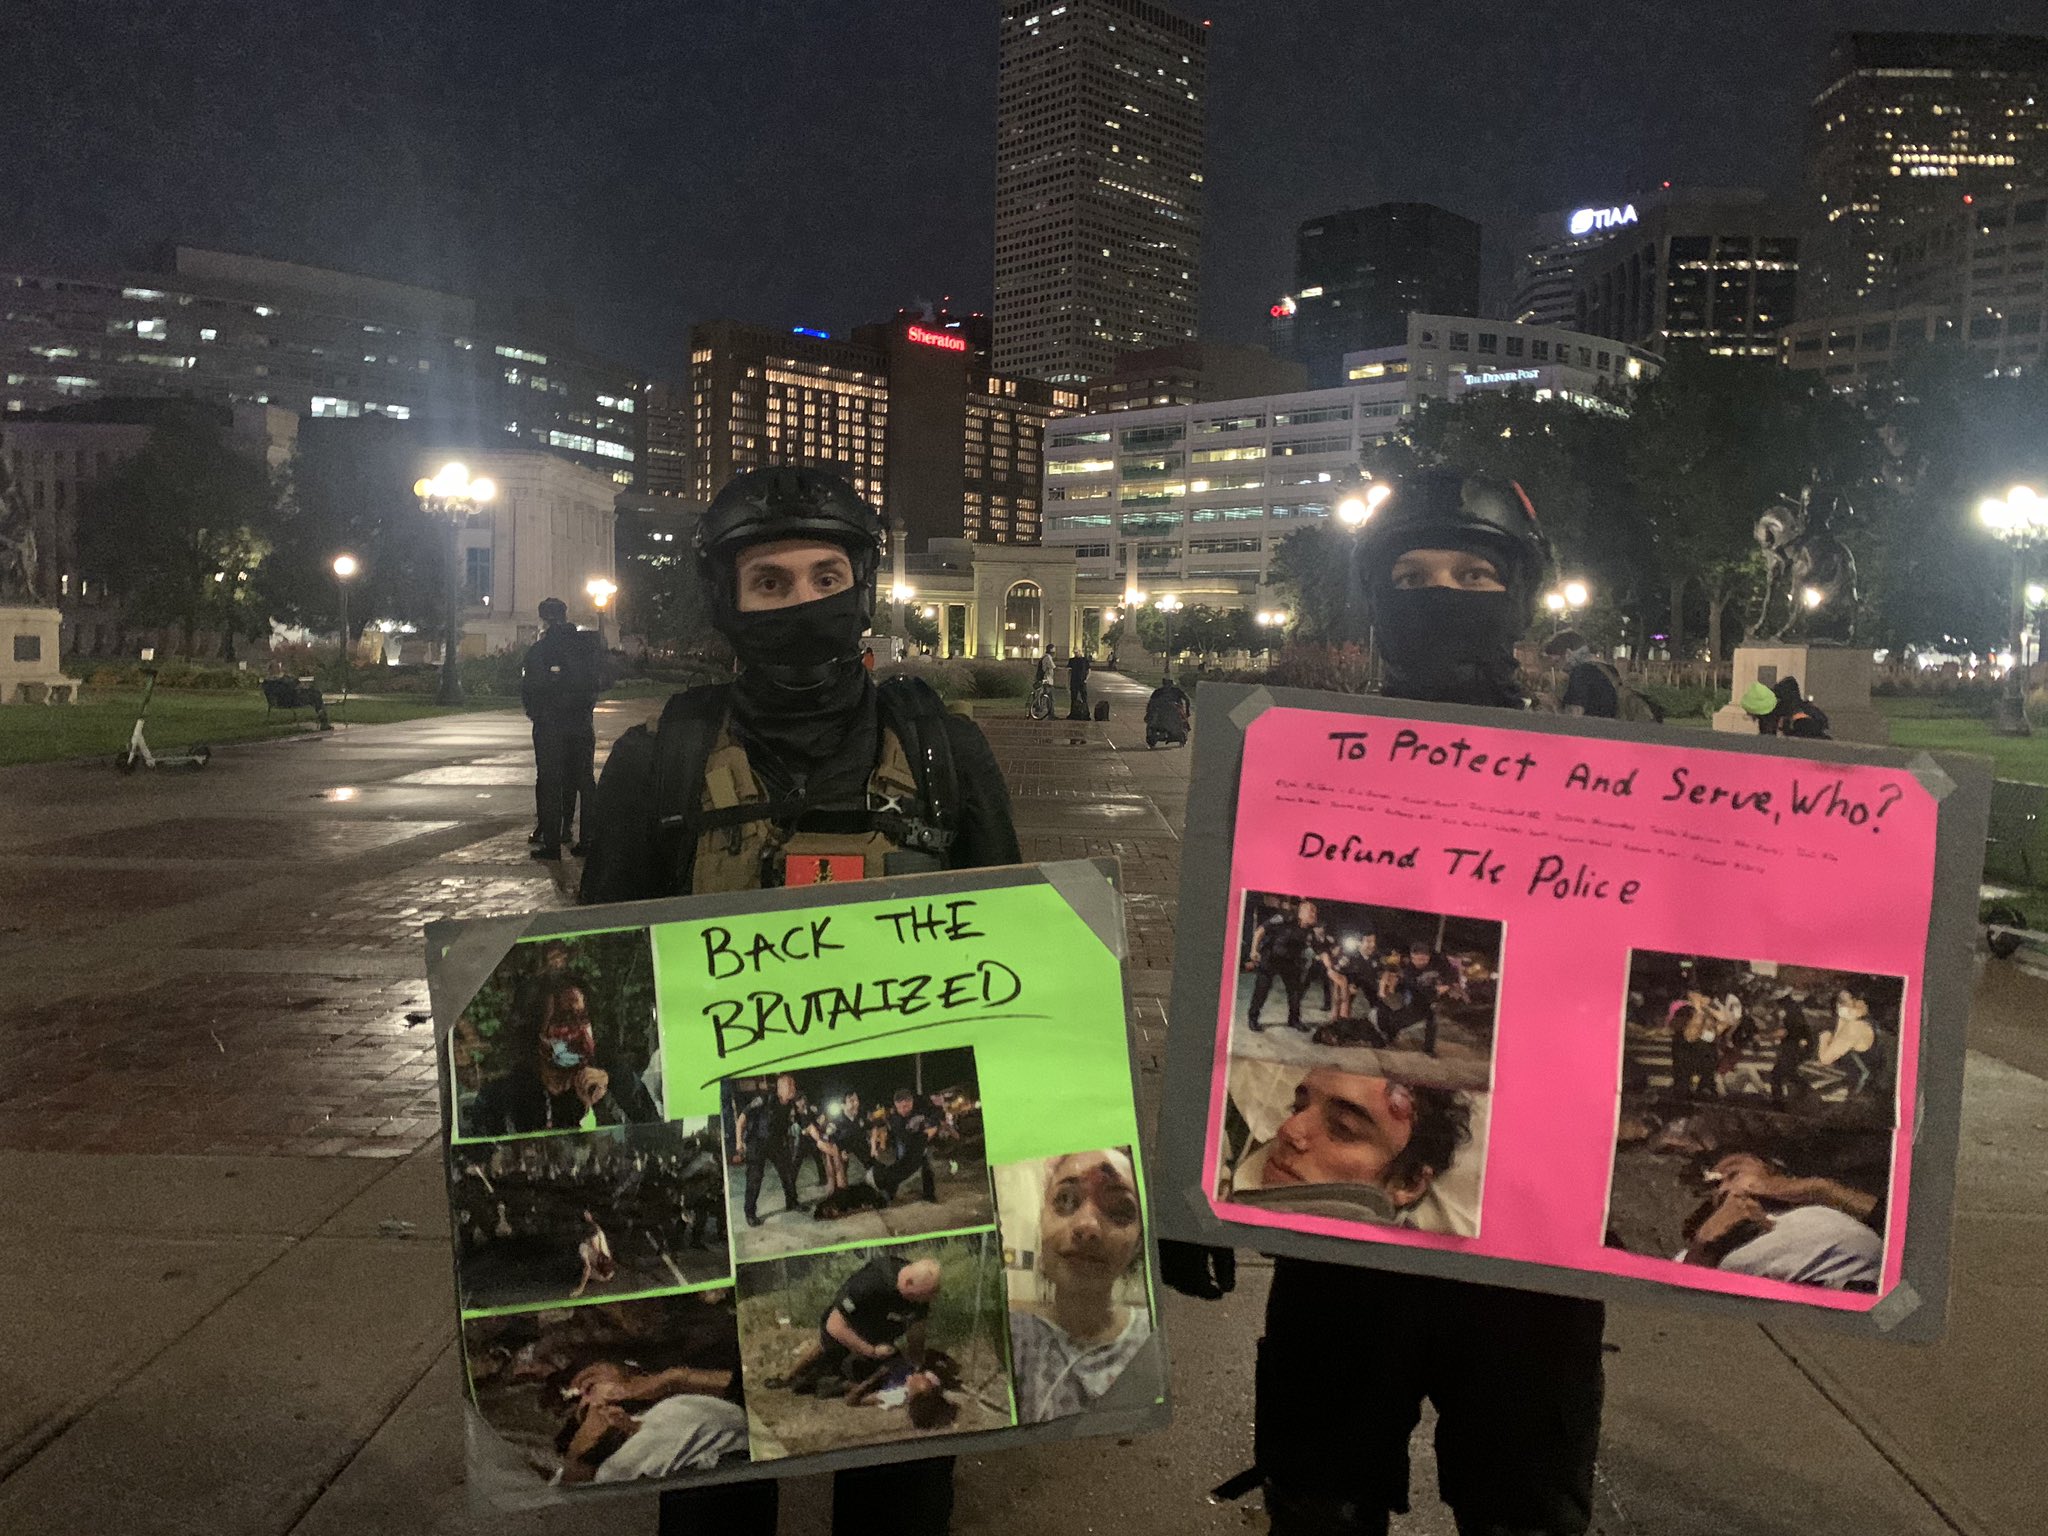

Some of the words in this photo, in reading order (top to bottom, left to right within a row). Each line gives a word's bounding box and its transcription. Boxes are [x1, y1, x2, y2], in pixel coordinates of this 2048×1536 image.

[1593, 204, 1638, 229] TIAA
[908, 326, 966, 351] Sheraton
[1328, 731, 1369, 761] To
[1390, 729, 1537, 781] Protect
[1565, 763, 1637, 797] And
[1791, 779, 1903, 834] Who?
[1299, 832, 1420, 869] Defund
[1443, 847, 1505, 886] The
[1526, 854, 1641, 905] Police
[700, 916, 846, 980] BACK
[874, 900, 986, 944] THE
[702, 960, 1022, 1059] BRUTALIZED
